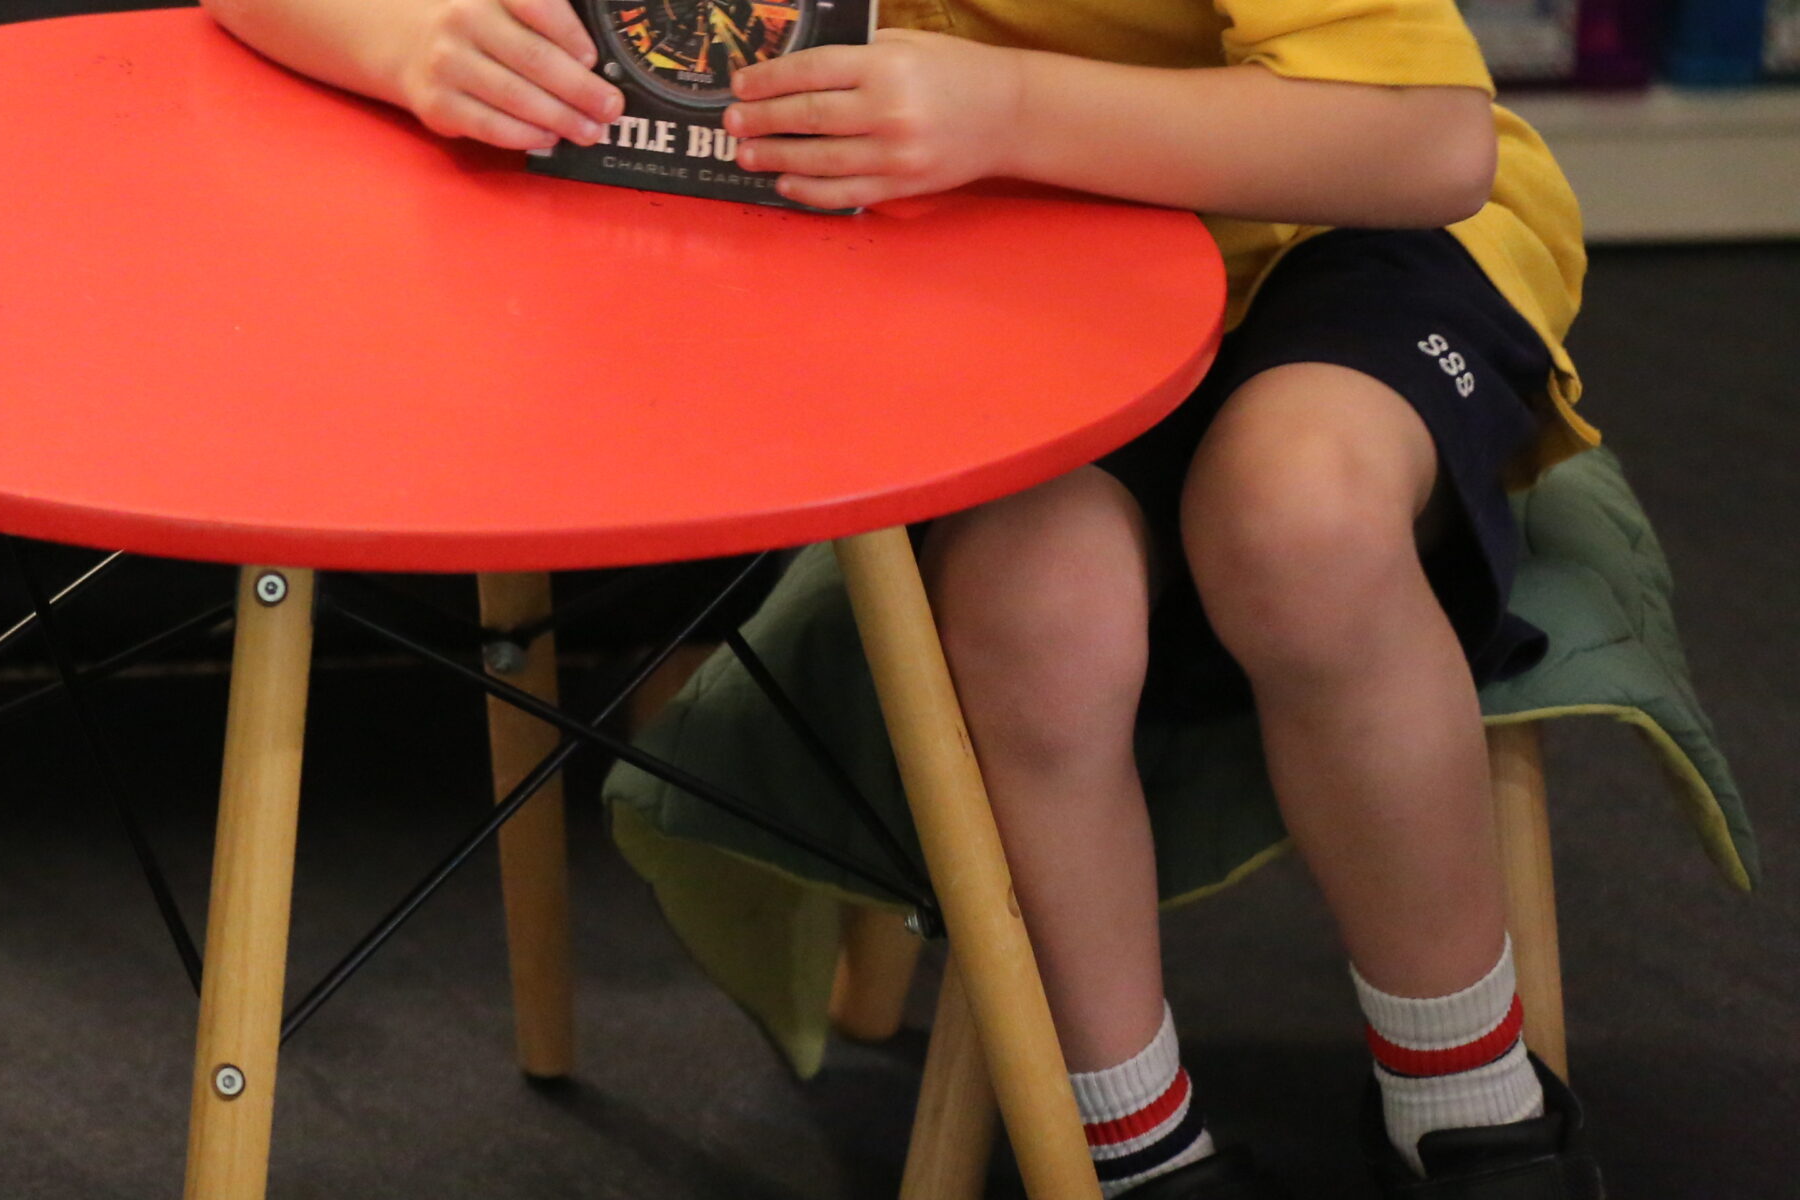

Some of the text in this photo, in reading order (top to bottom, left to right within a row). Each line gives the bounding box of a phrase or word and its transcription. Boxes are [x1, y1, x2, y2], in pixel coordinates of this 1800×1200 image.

[686, 125, 738, 162] BU
[602, 155, 689, 180] CHARLIE
[1416, 333, 1475, 398] SSS
